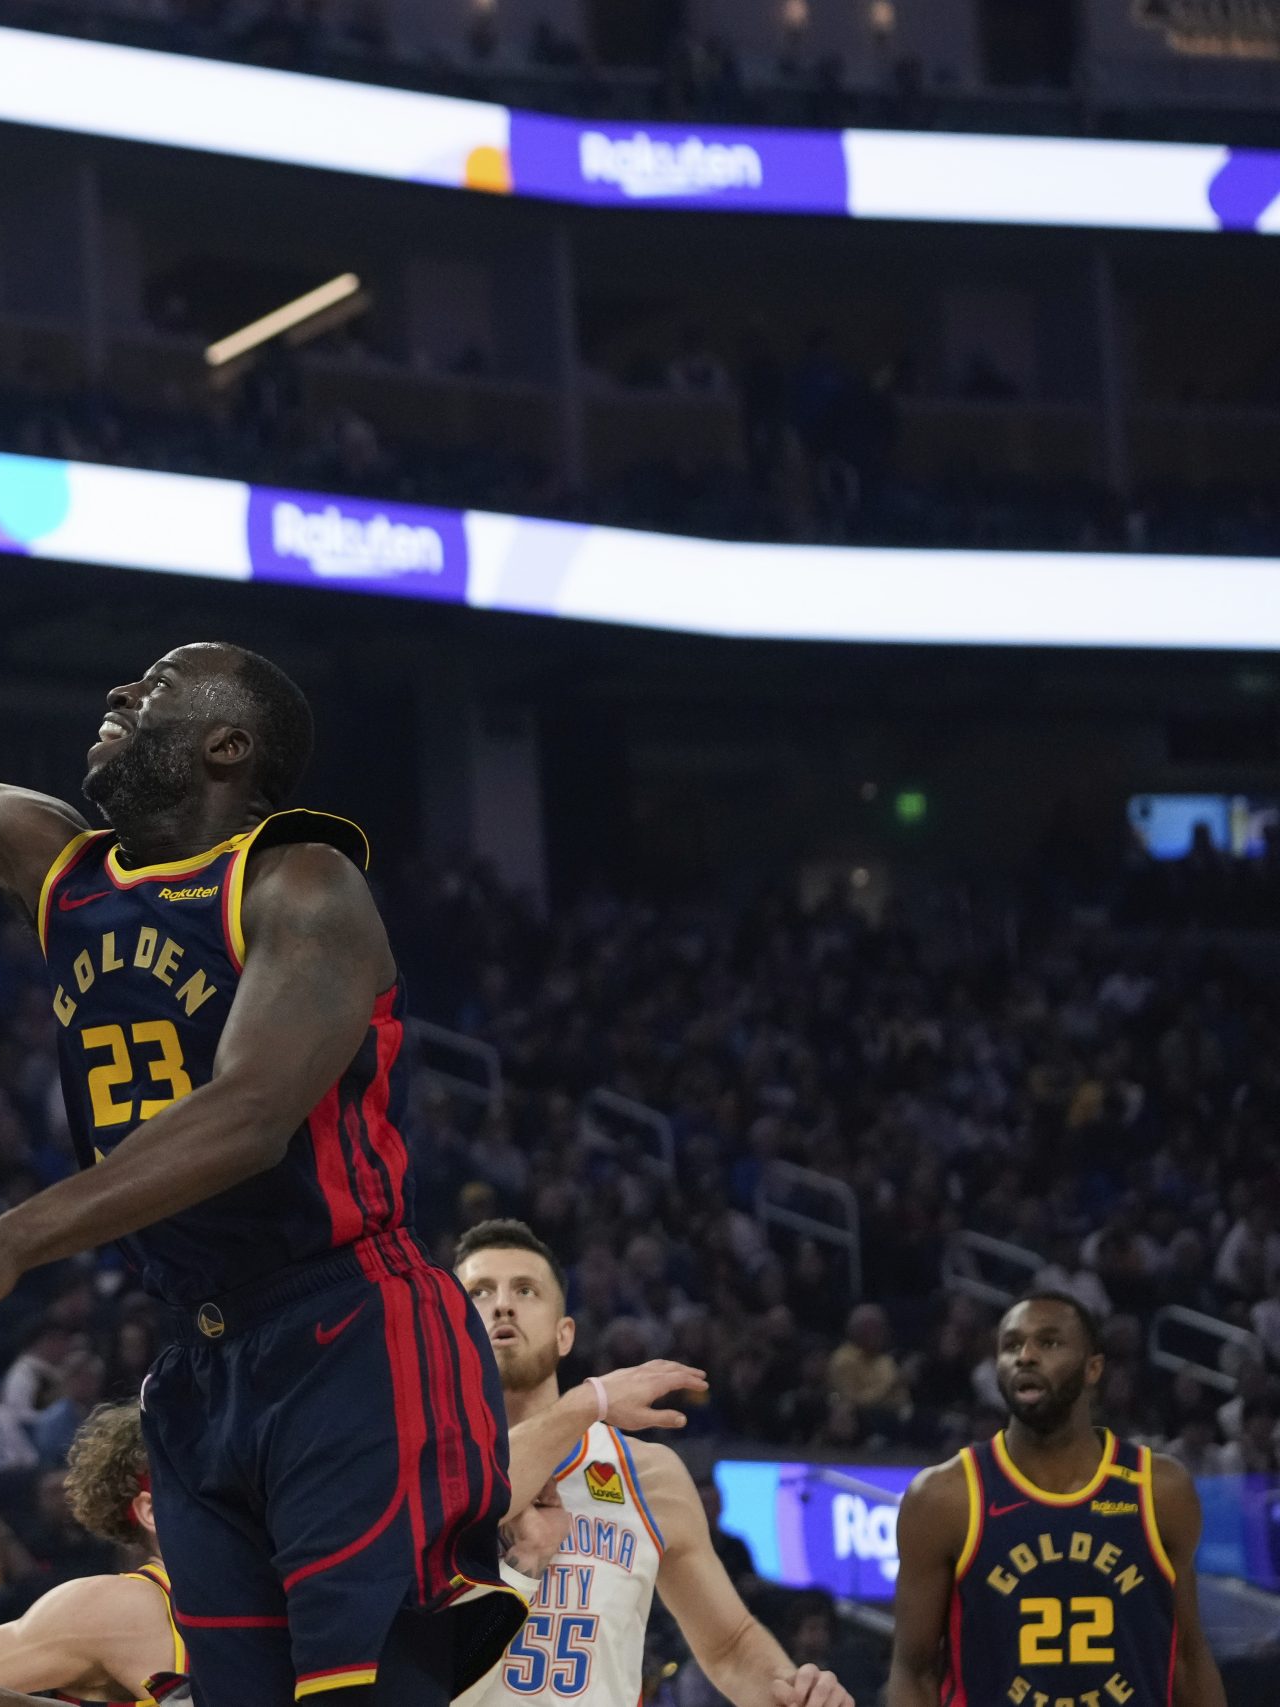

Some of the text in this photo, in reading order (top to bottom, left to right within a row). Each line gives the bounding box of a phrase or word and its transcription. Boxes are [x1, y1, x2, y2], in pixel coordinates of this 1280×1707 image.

[579, 131, 763, 198] Rakuten
[273, 501, 443, 578] Rakuten
[158, 885, 219, 902] Rakuten
[52, 926, 218, 1027] GOLDEN
[80, 1020, 194, 1128] 23
[1090, 1500, 1139, 1516] Rakuten
[529, 1564, 594, 1610] ITY
[986, 1531, 1145, 1596] GOLDEN
[503, 1612, 600, 1698] 55
[1019, 1596, 1116, 1665] 22
